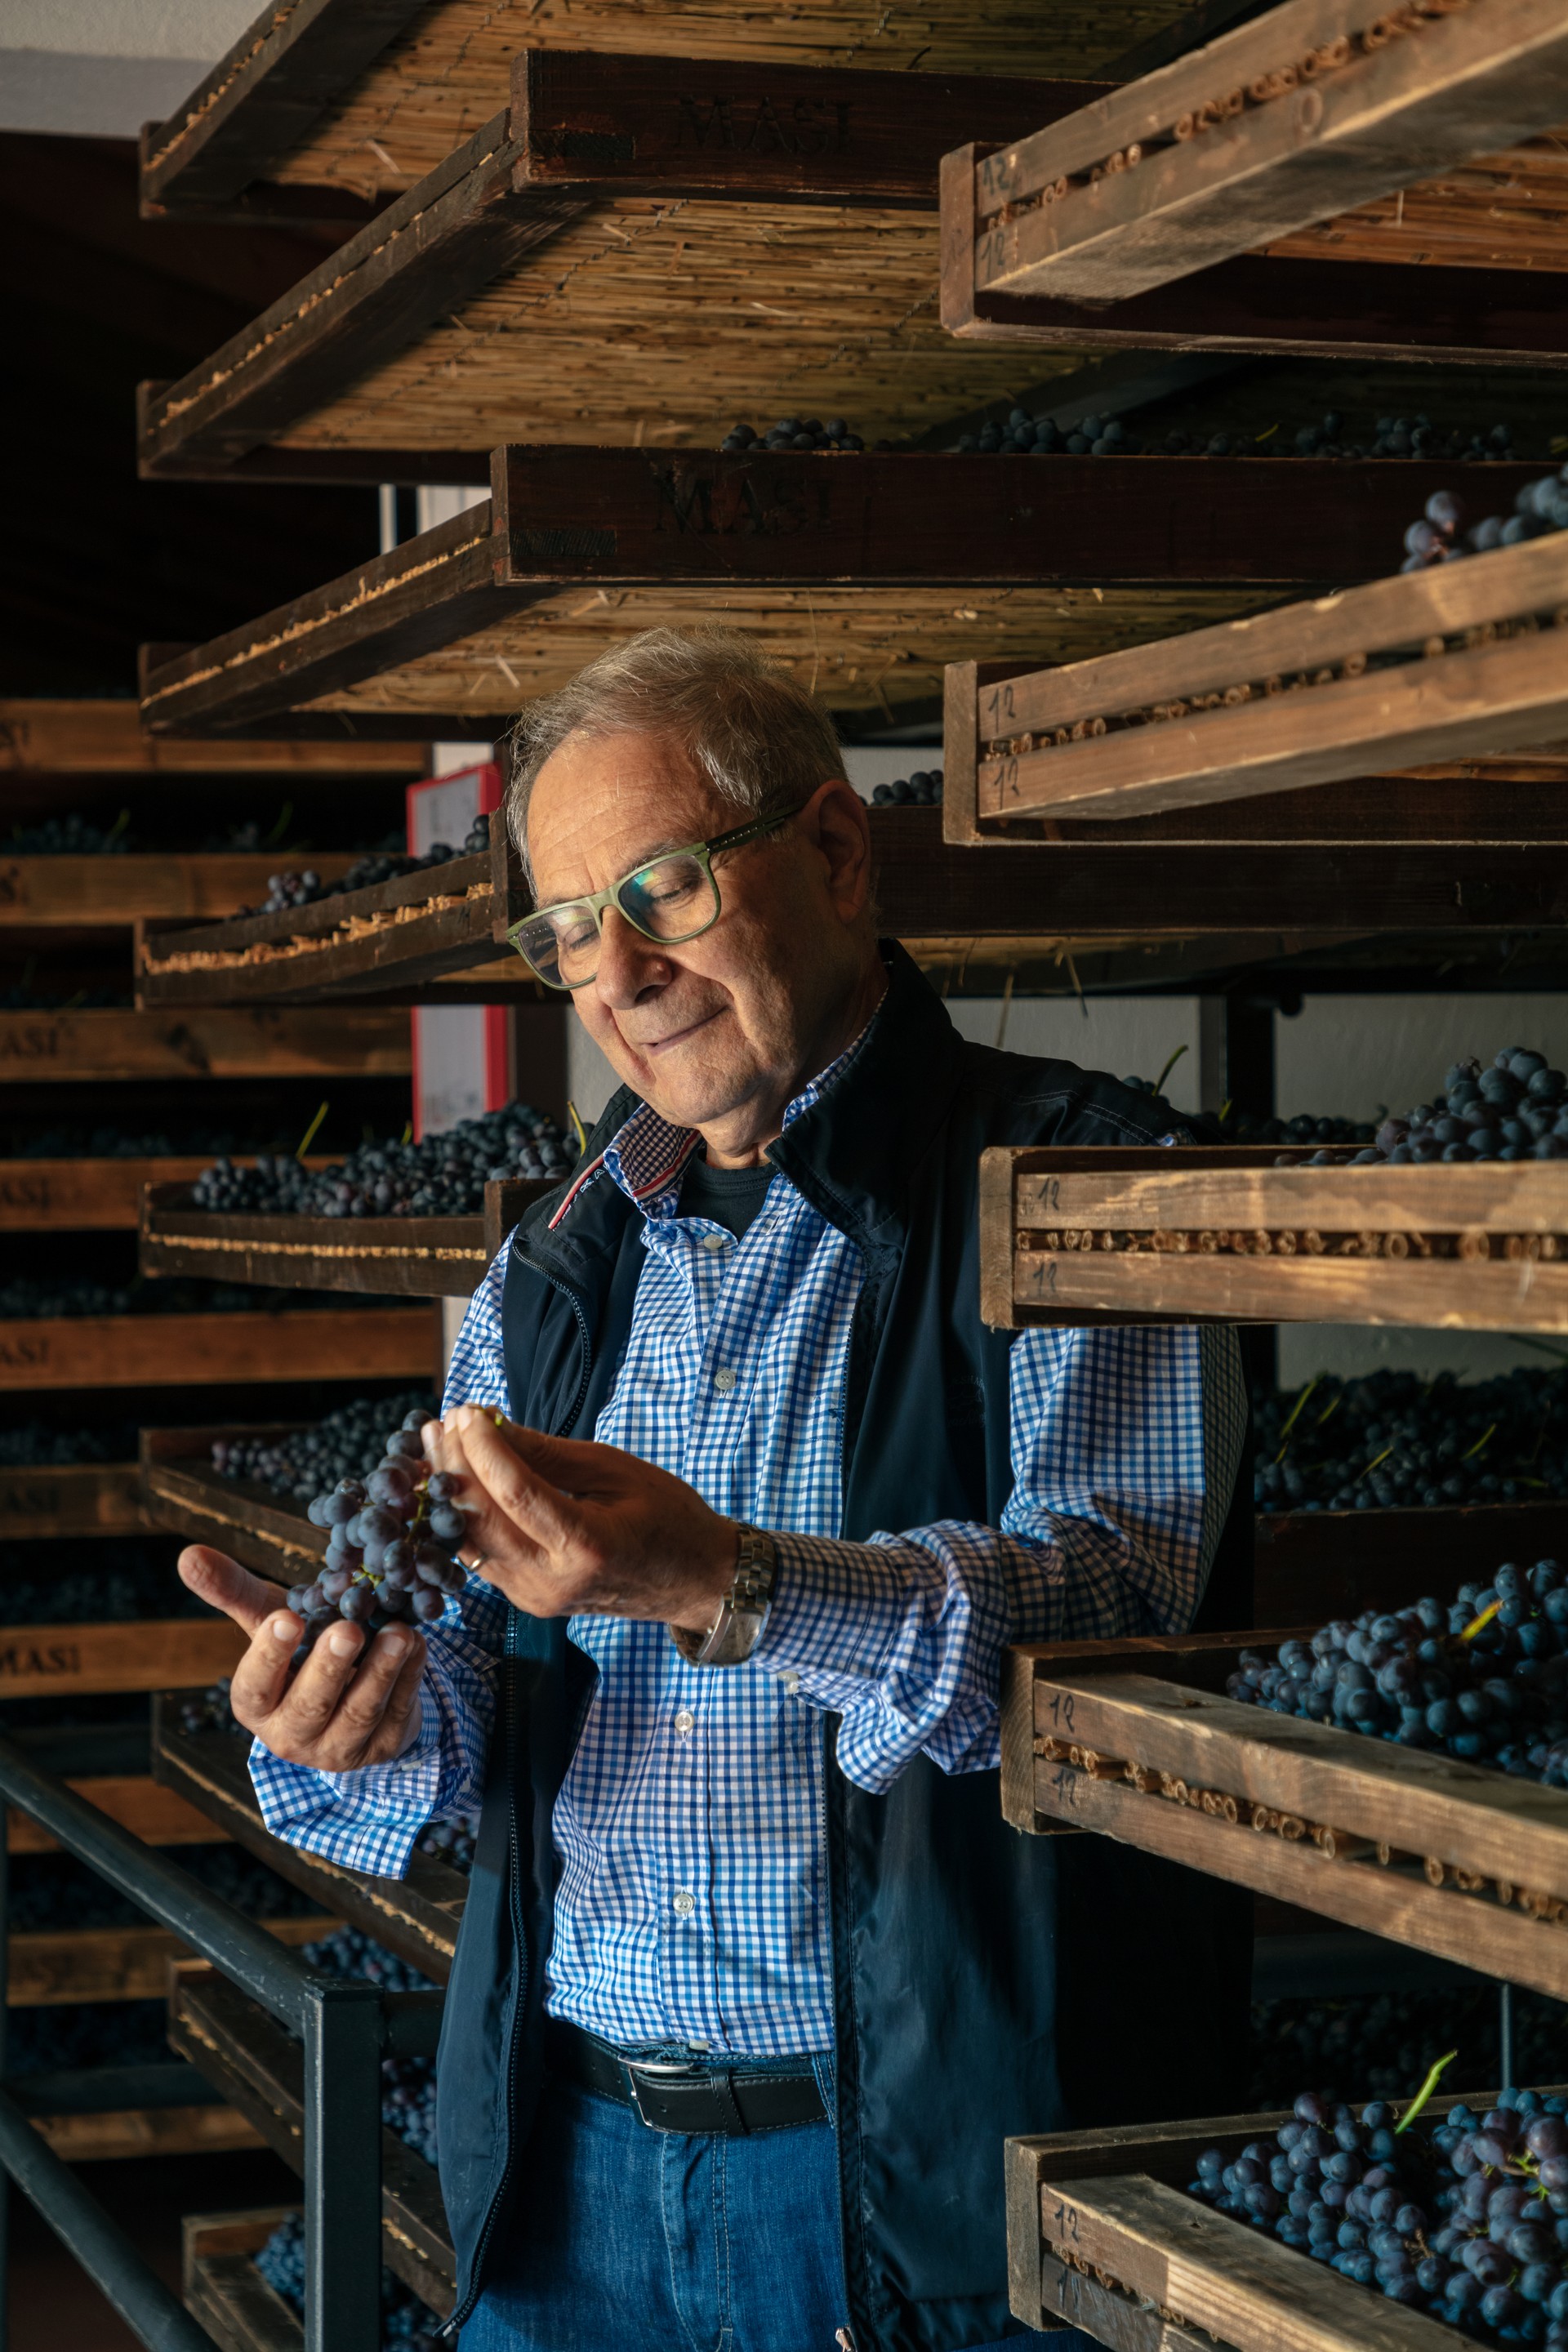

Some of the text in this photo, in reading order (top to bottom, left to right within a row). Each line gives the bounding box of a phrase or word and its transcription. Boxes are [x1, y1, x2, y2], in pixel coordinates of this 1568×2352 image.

[673, 94, 853, 154] MASI
[653, 477, 834, 535] MASI
[1038, 1177, 1059, 1210] 12
[1049, 1694, 1075, 1733] 12
[1054, 2204, 1079, 2243] 12
